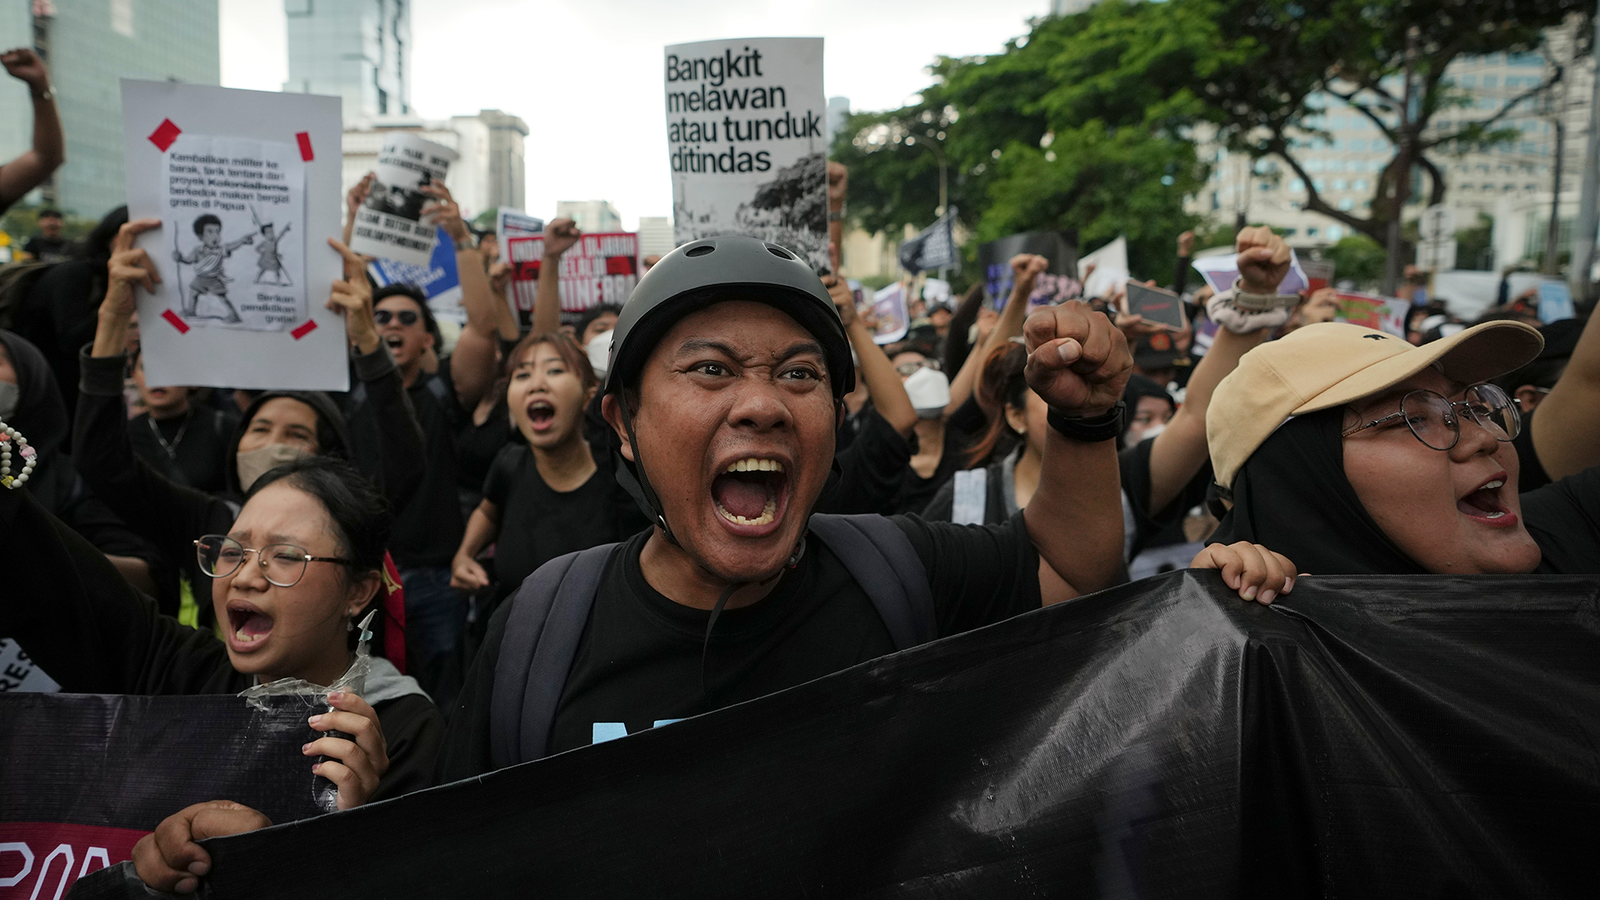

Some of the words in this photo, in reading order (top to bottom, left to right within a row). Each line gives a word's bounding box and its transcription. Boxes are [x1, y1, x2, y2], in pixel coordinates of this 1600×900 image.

[667, 46, 763, 87] Bangkit
[668, 84, 786, 113] melawan
[669, 117, 718, 142] atau
[723, 110, 822, 142] tunduk
[170, 152, 229, 166] Kembalikan
[231, 157, 264, 168] militer
[265, 160, 279, 170] ke
[671, 145, 772, 173] ditindas
[170, 164, 201, 175] barak,
[203, 166, 225, 177] tarik
[228, 168, 264, 180] tentara
[265, 171, 286, 181] dari
[170, 176, 205, 189] proyek
[170, 187, 216, 198] berkedok
[219, 190, 255, 201] makan
[256, 193, 290, 205] bergizi
[170, 198, 199, 209] gratis
[201, 199, 212, 209] di
[213, 200, 246, 212] Papua
